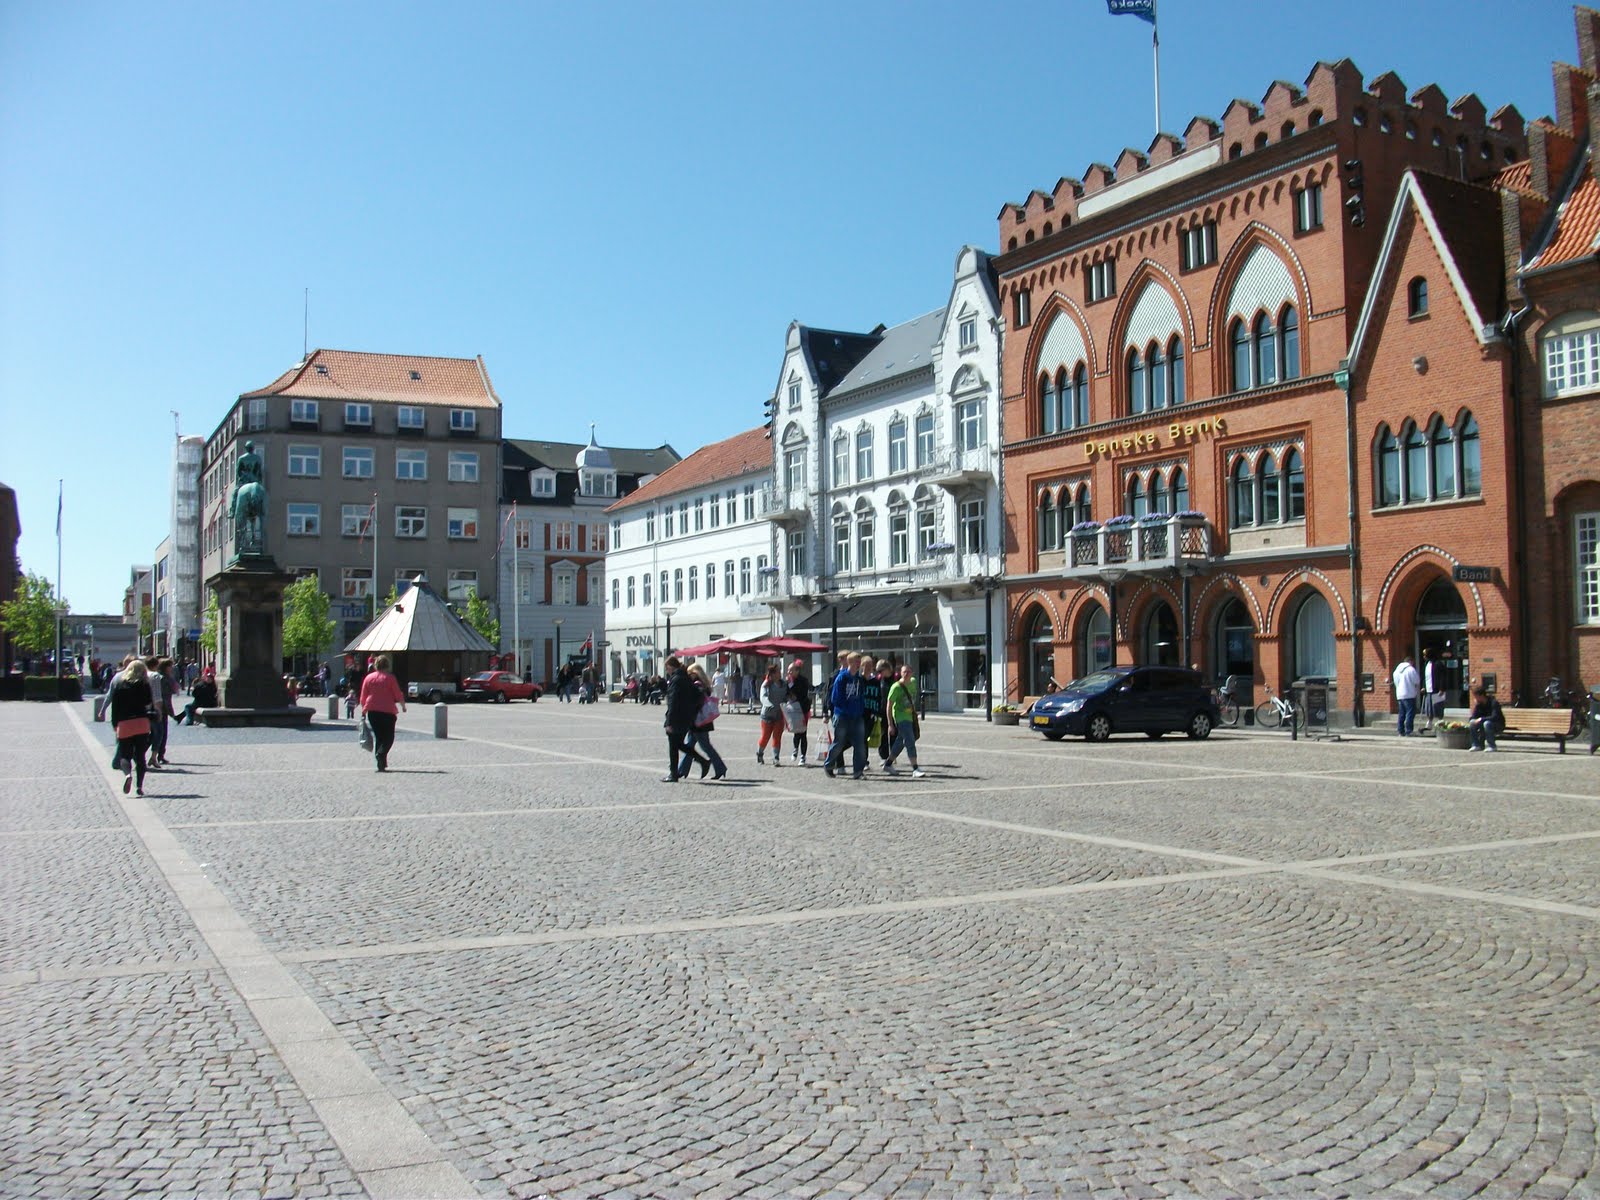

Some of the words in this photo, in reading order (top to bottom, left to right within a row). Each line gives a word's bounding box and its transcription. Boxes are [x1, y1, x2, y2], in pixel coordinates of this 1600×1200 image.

[1083, 431, 1155, 456] Danske
[1168, 415, 1223, 439] Bank
[1460, 568, 1490, 580] Bank
[626, 635, 654, 647] FONA
